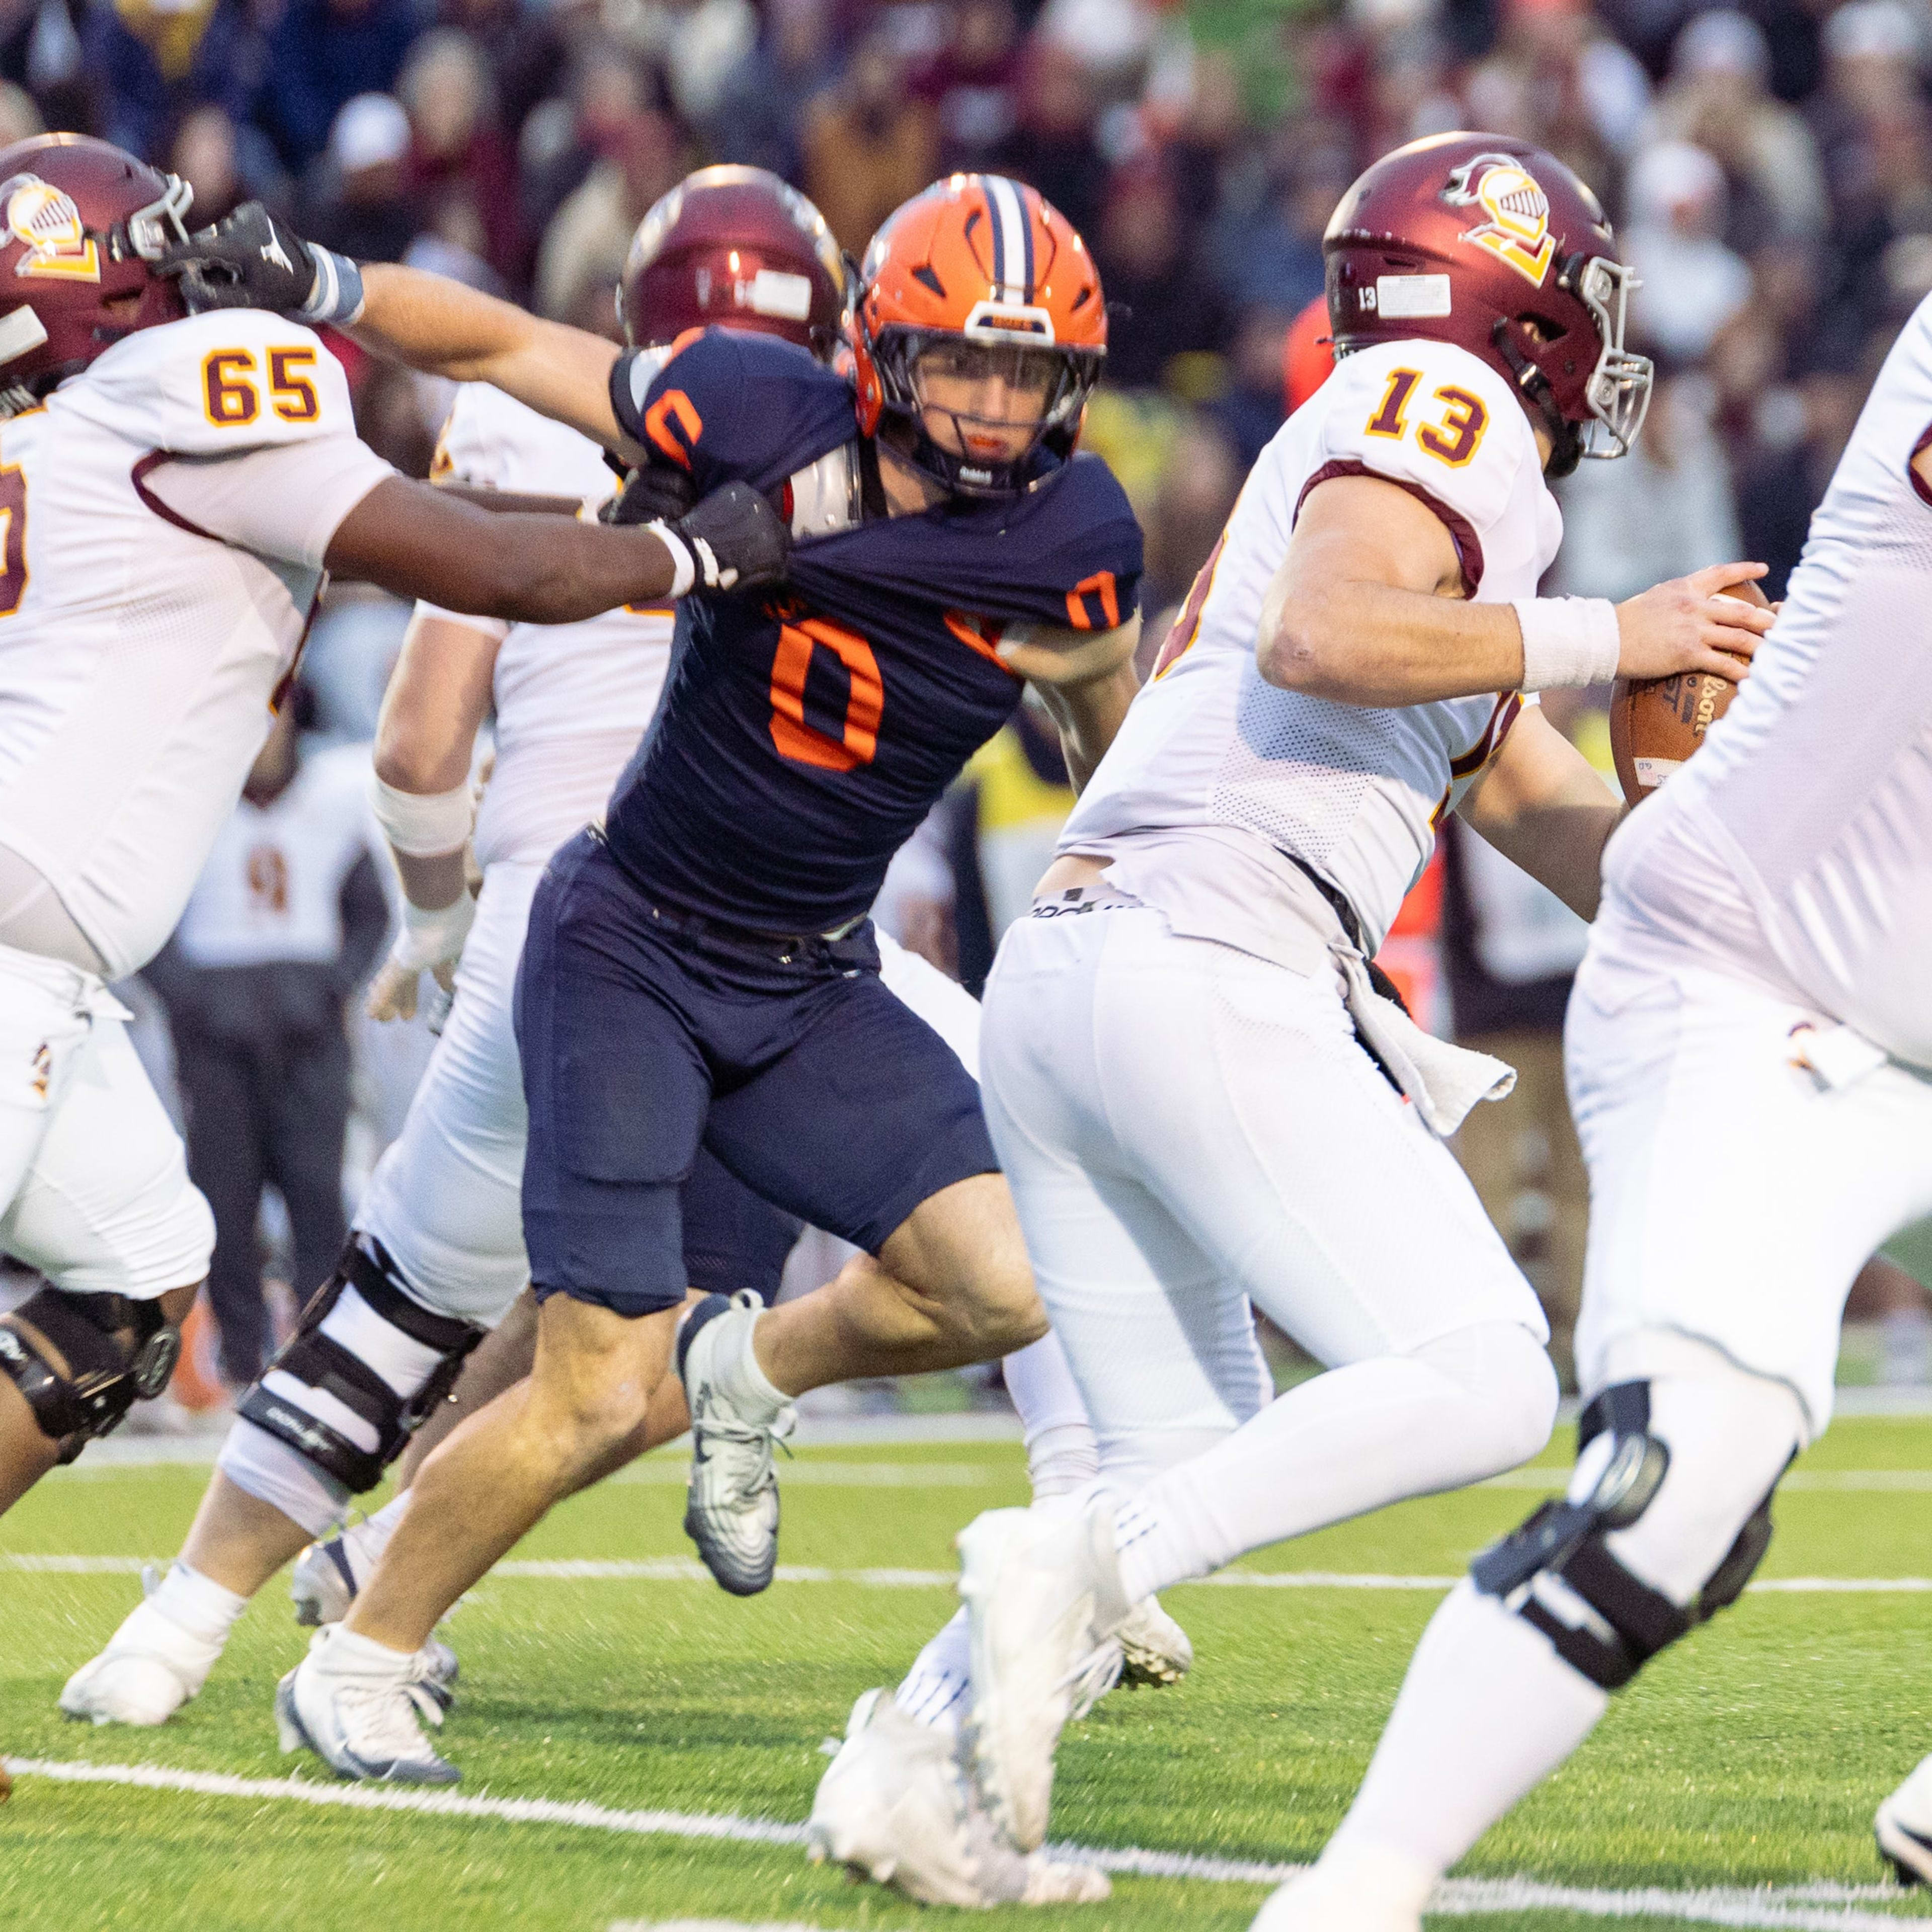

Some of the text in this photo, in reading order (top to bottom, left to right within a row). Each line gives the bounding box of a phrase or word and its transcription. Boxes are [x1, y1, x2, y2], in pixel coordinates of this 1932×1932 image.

[1358, 287, 1377, 311] 13
[201, 346, 321, 429] 65
[1364, 366, 1490, 468] 13
[769, 618, 884, 772] 0
